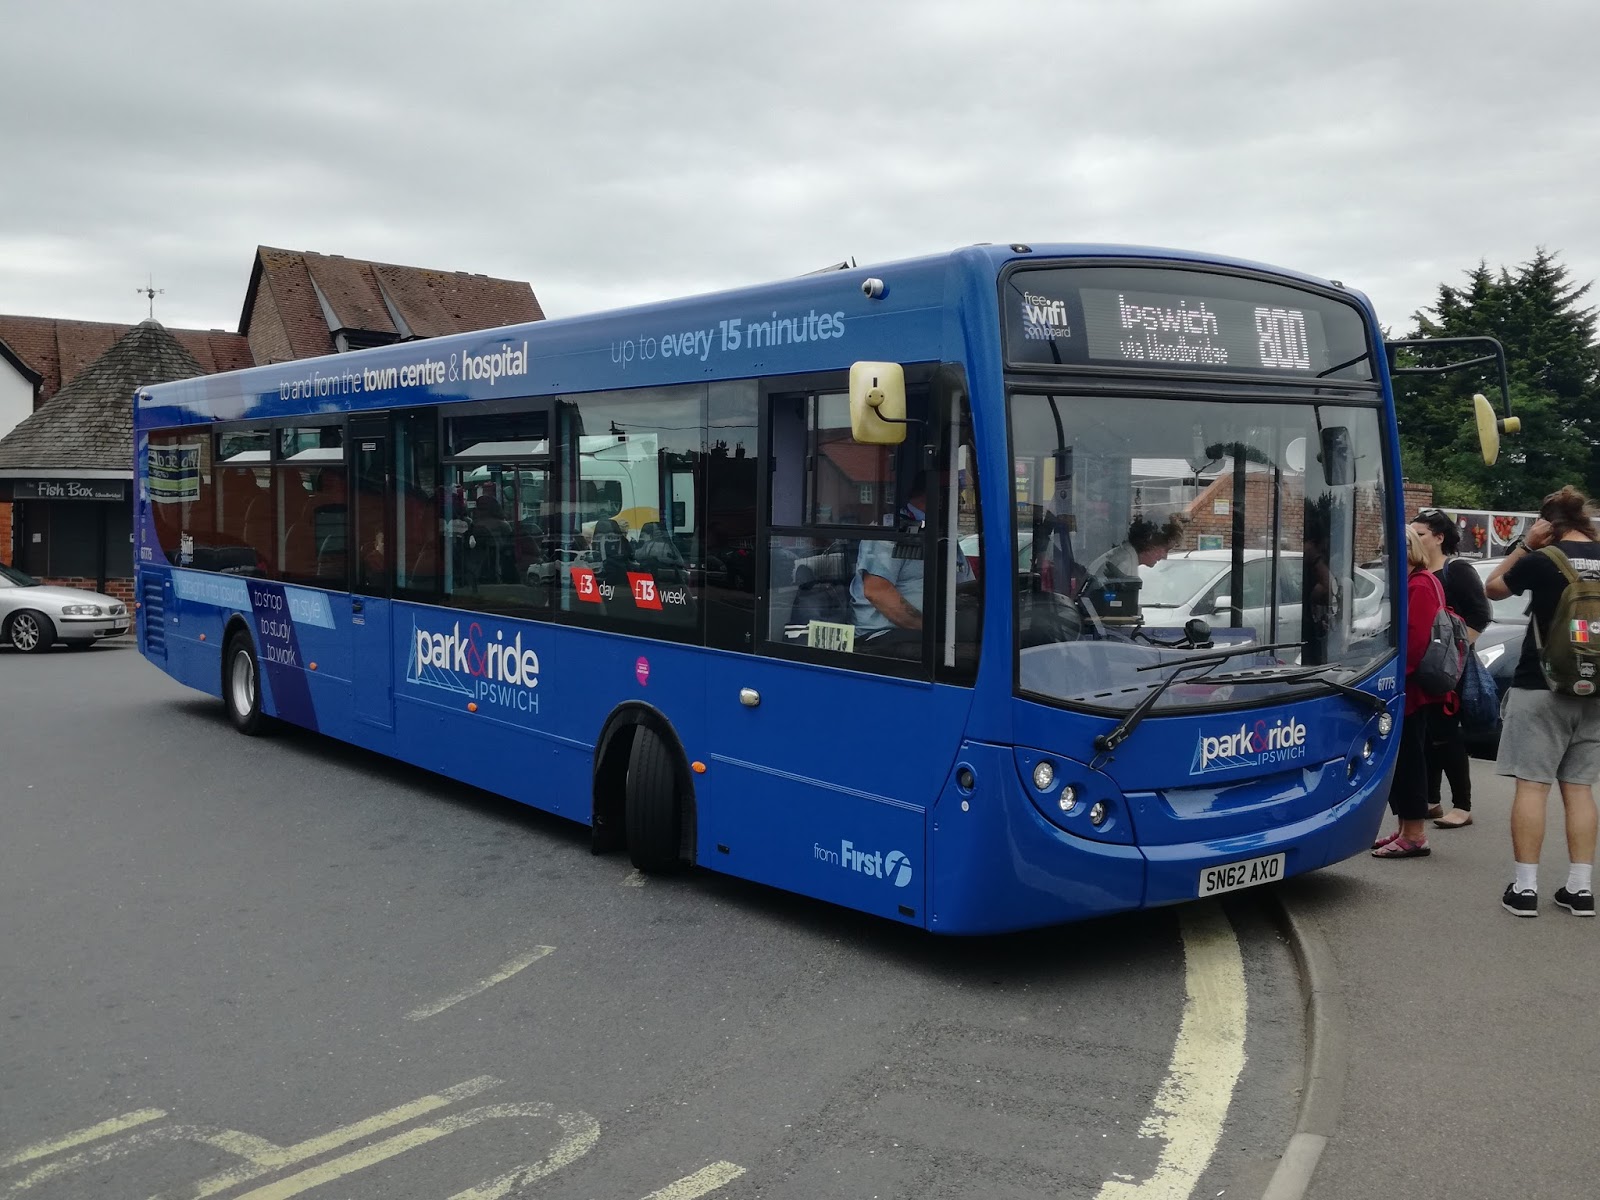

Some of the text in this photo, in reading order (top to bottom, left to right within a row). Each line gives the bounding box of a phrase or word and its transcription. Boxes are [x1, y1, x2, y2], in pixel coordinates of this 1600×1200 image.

[1024, 291, 1046, 306] free
[1025, 300, 1067, 326] wifi
[611, 309, 845, 369] up to every 15 minutes
[1043, 326, 1071, 338] board
[1118, 294, 1310, 369] Ipswich 800
[1120, 335, 1144, 359] via
[280, 341, 528, 400] to and from the town centre & hospital
[38, 481, 64, 496] Fish
[67, 481, 93, 497] Box
[580, 574, 615, 600] £3 day
[635, 580, 686, 605] £13 week
[254, 588, 282, 614] to shop
[301, 599, 321, 622] style
[261, 618, 291, 643] to study
[267, 643, 297, 666] to work
[1377, 676, 1396, 692] 67775
[475, 680, 539, 714] IPSWICH
[1258, 747, 1306, 765] IPSWICH
[814, 839, 882, 879] from First
[1206, 858, 1279, 891] SN62 AXO
